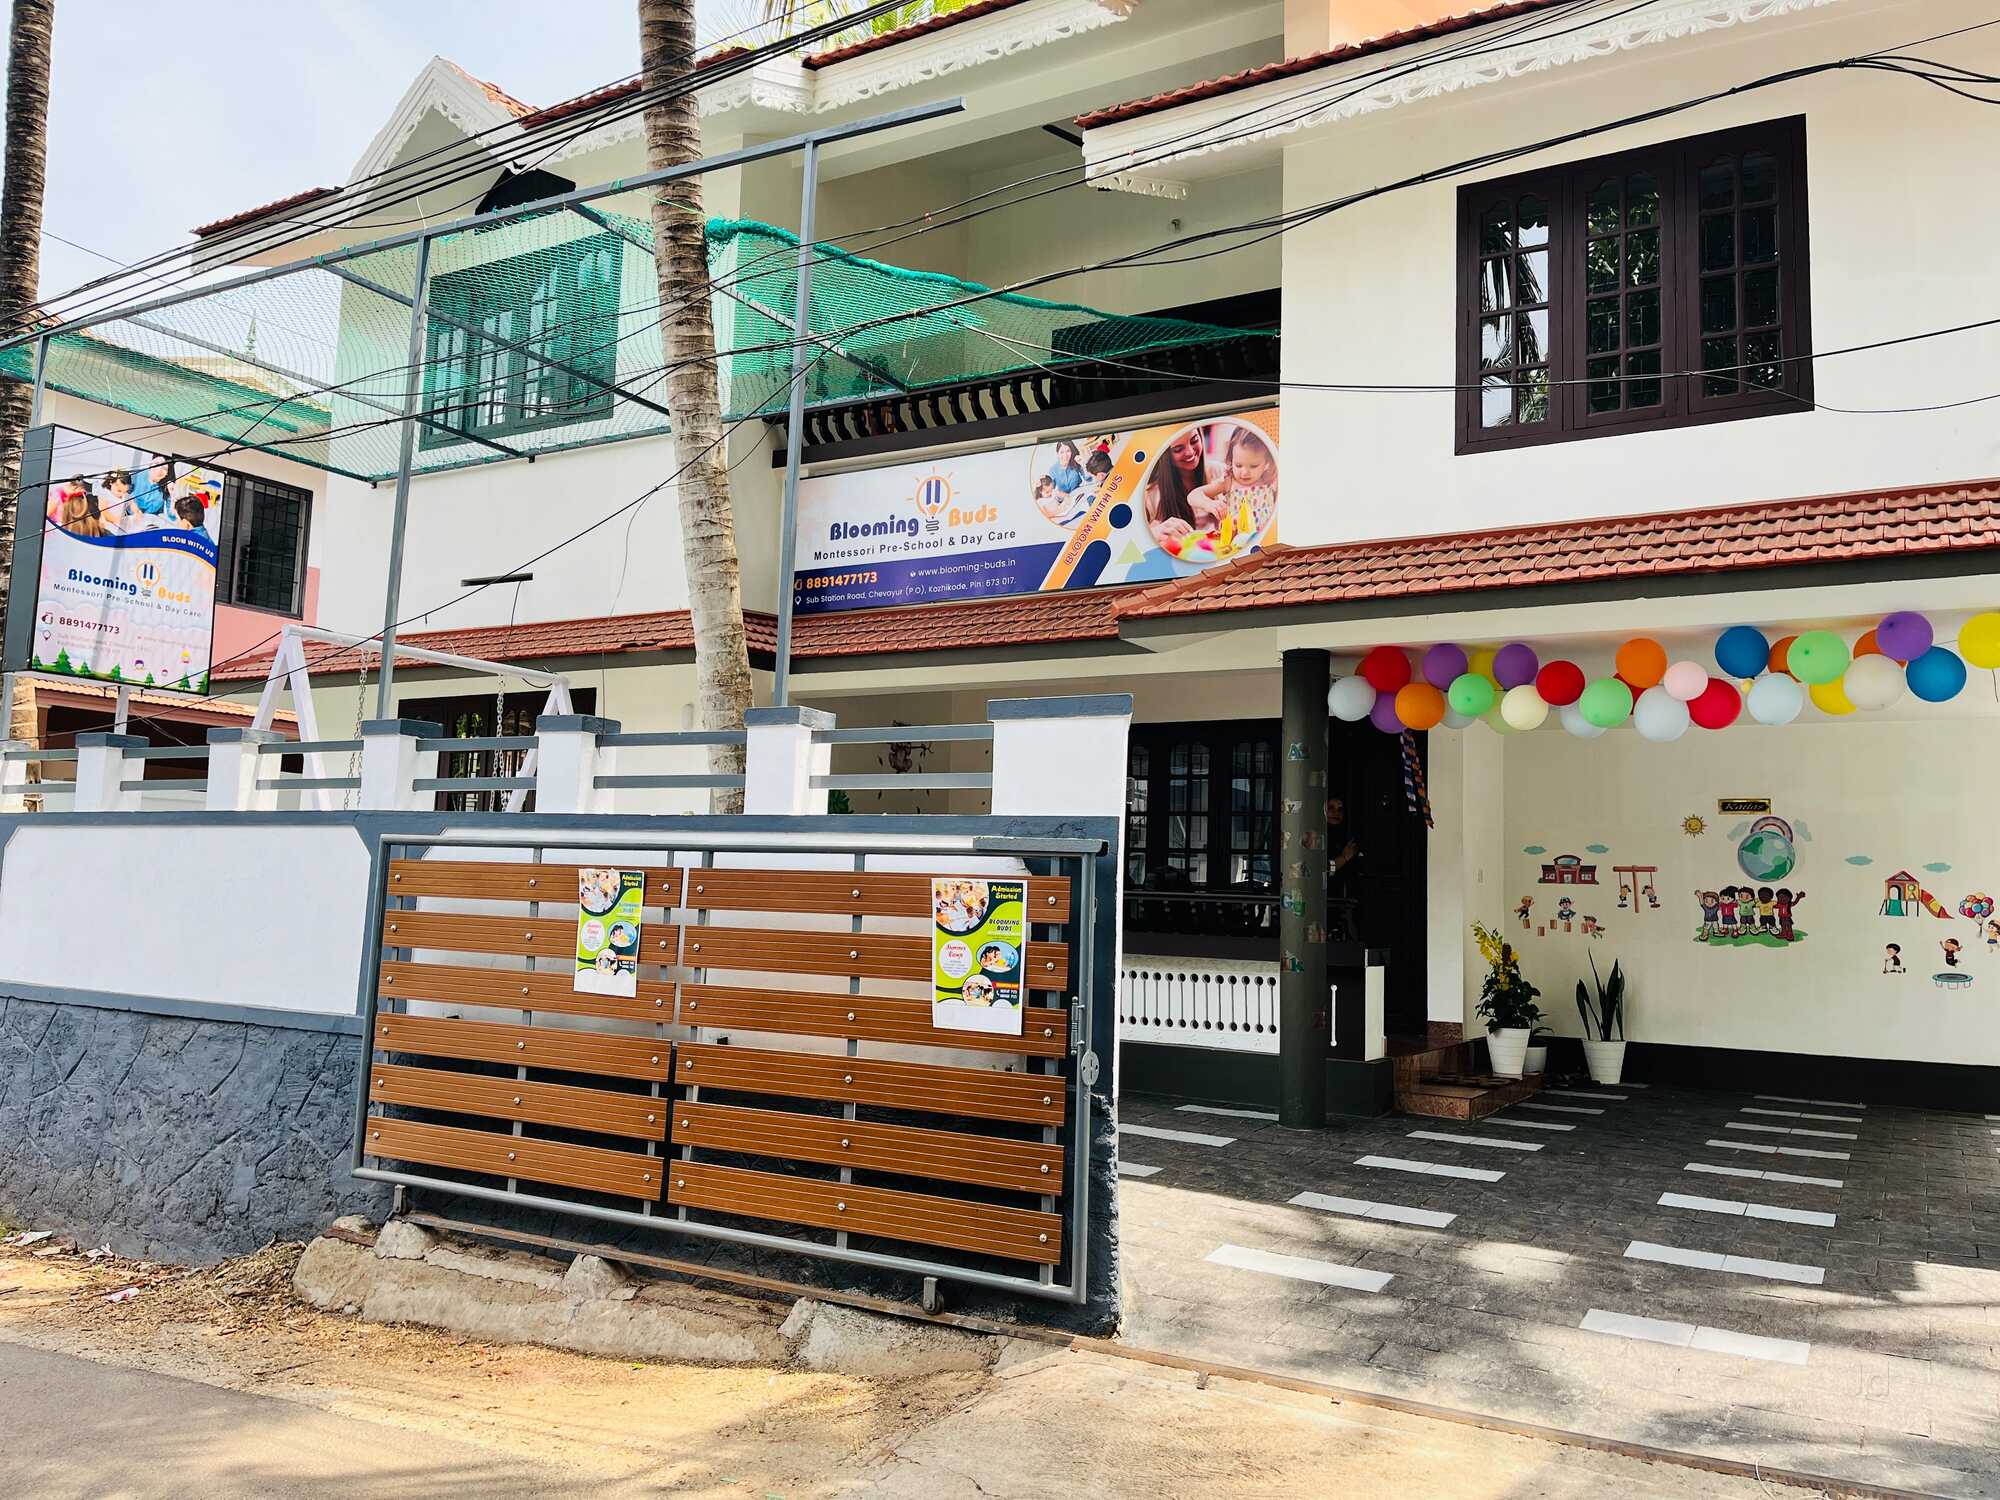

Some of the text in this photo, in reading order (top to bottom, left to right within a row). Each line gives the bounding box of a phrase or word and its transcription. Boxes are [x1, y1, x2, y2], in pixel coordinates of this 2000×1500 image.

[830, 504, 1000, 541] Blooming Buds
[1064, 474, 1123, 566] BLOOM WITH US
[162, 535, 215, 558] BLOOM WITH US
[814, 530, 1016, 561] Montessori Pre-School & Day Care
[918, 558, 1016, 577] www.blooming-buds.in
[67, 568, 192, 604] Blooming Buds
[806, 571, 878, 589] 8891477173
[53, 583, 103, 599] Montessori
[165, 605, 181, 616] Day
[805, 595, 820, 605] Sub
[820, 592, 846, 603] Station
[59, 616, 121, 635] 8891477173
[991, 885, 1022, 894] Admission
[996, 892, 1018, 900] Started
[988, 918, 1020, 926] BLOOMING
